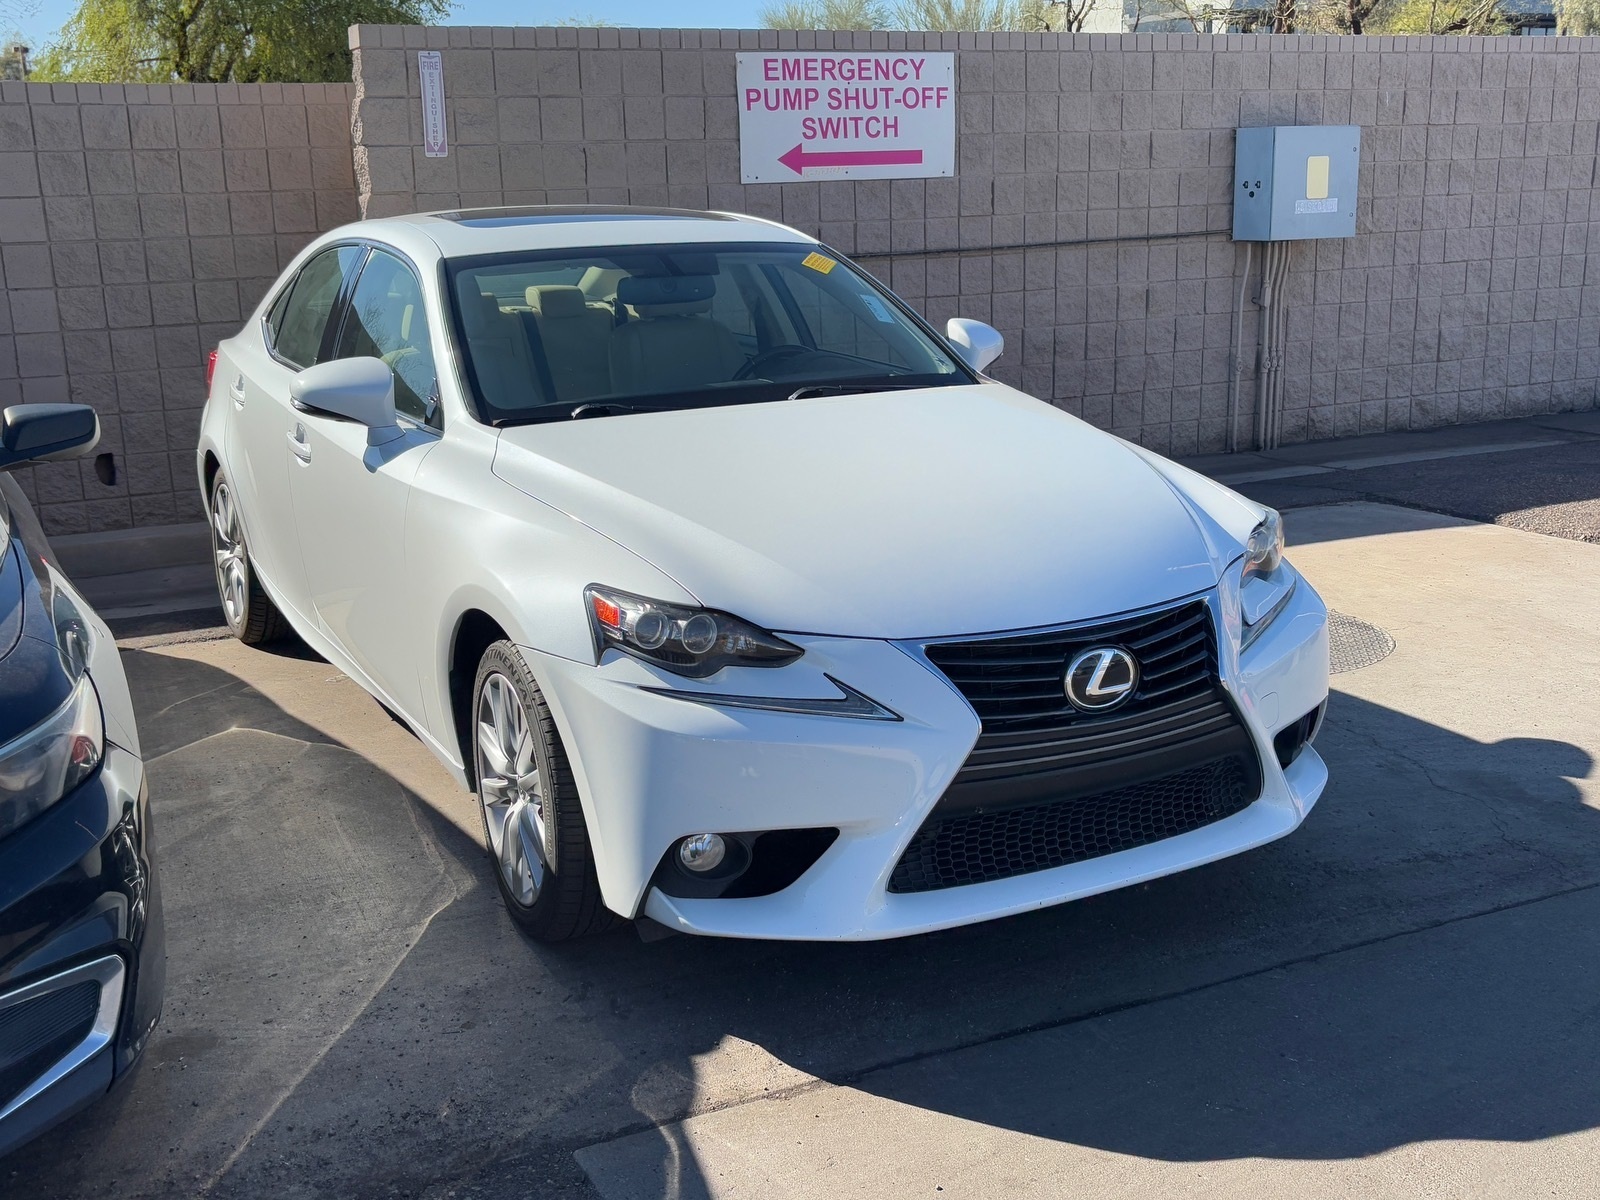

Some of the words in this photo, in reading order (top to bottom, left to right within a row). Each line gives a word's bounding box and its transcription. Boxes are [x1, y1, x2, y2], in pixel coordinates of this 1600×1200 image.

[422, 60, 439, 71] FIRE
[763, 58, 926, 82] EMERGENCY
[428, 71, 440, 148] EXTINGUISHER
[745, 87, 820, 112] PUMP
[827, 86, 949, 111] SHUT-OFF
[801, 115, 899, 140] SWITCH
